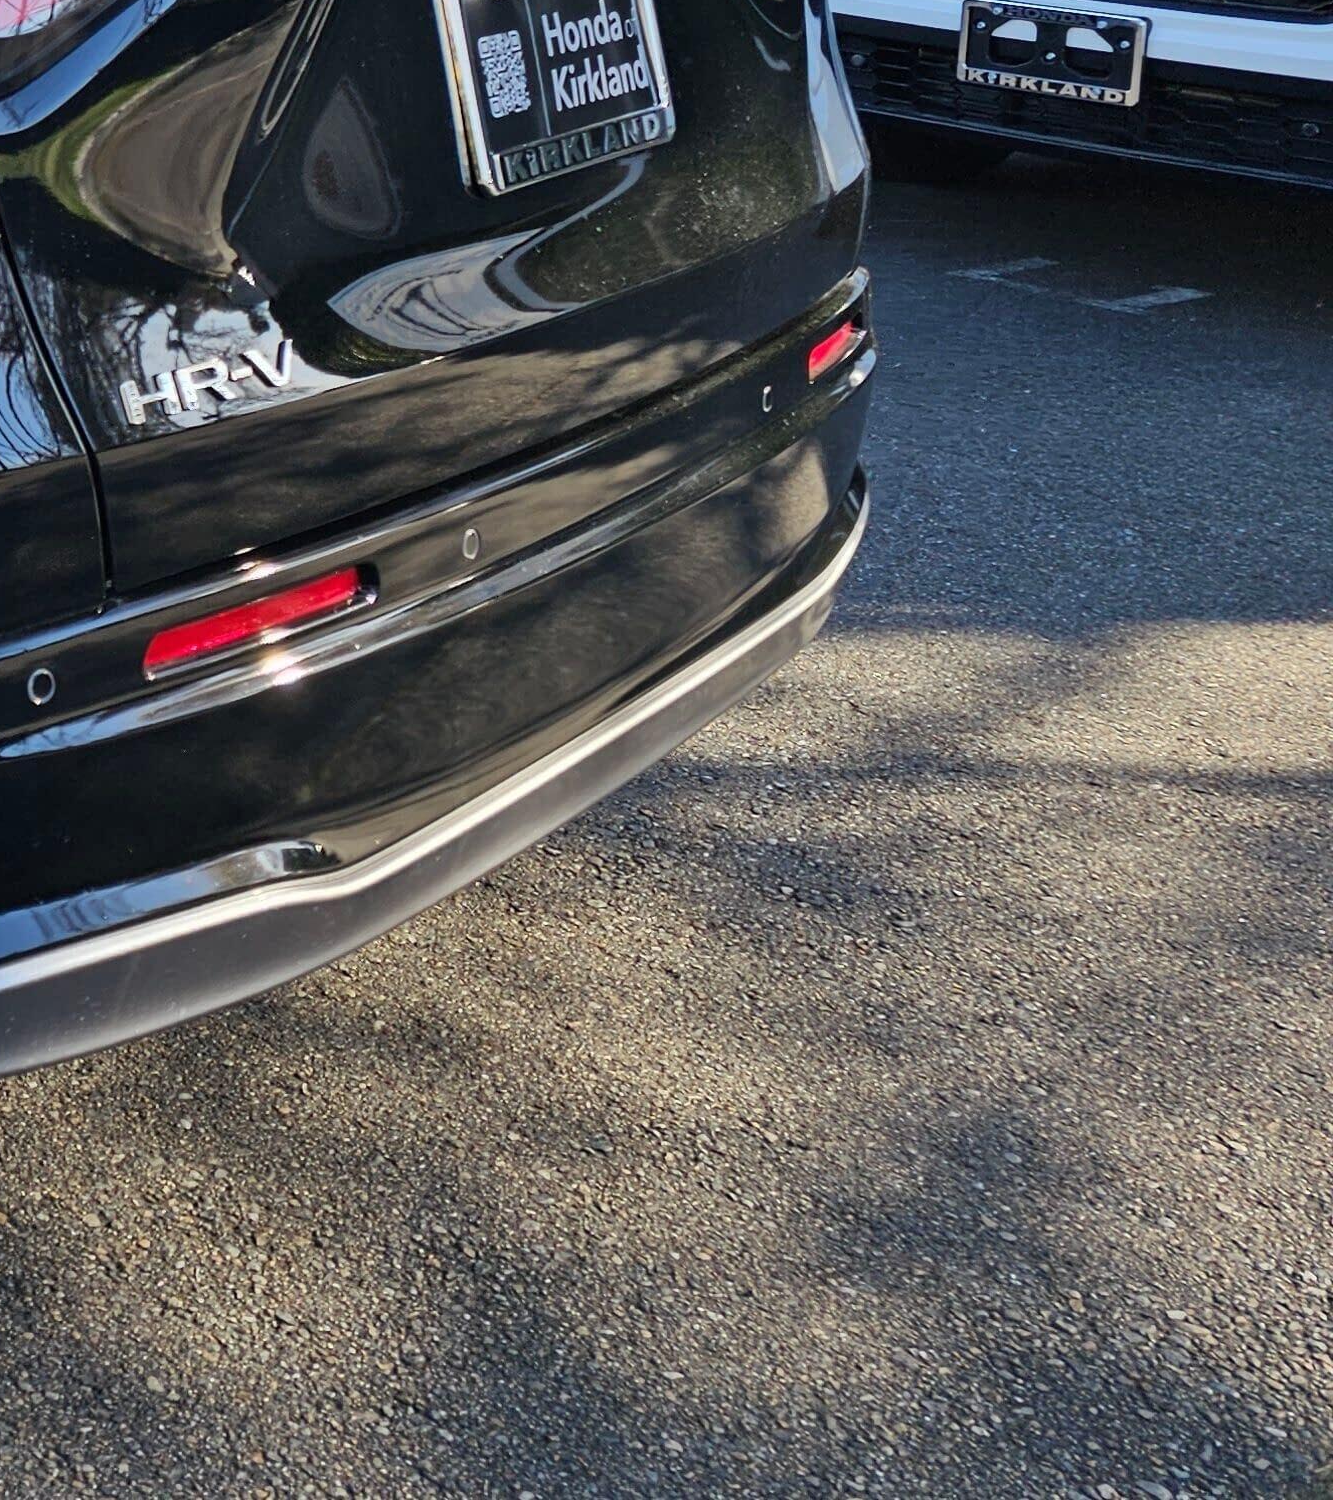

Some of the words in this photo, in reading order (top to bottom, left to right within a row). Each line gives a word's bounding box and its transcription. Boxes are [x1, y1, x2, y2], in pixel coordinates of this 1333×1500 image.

[541, 0, 623, 57] Honda
[1003, 6, 1096, 27] HONDA
[551, 44, 650, 112] Kirkland
[504, 113, 661, 184] KIRKLAND
[120, 338, 293, 426] HR-V
